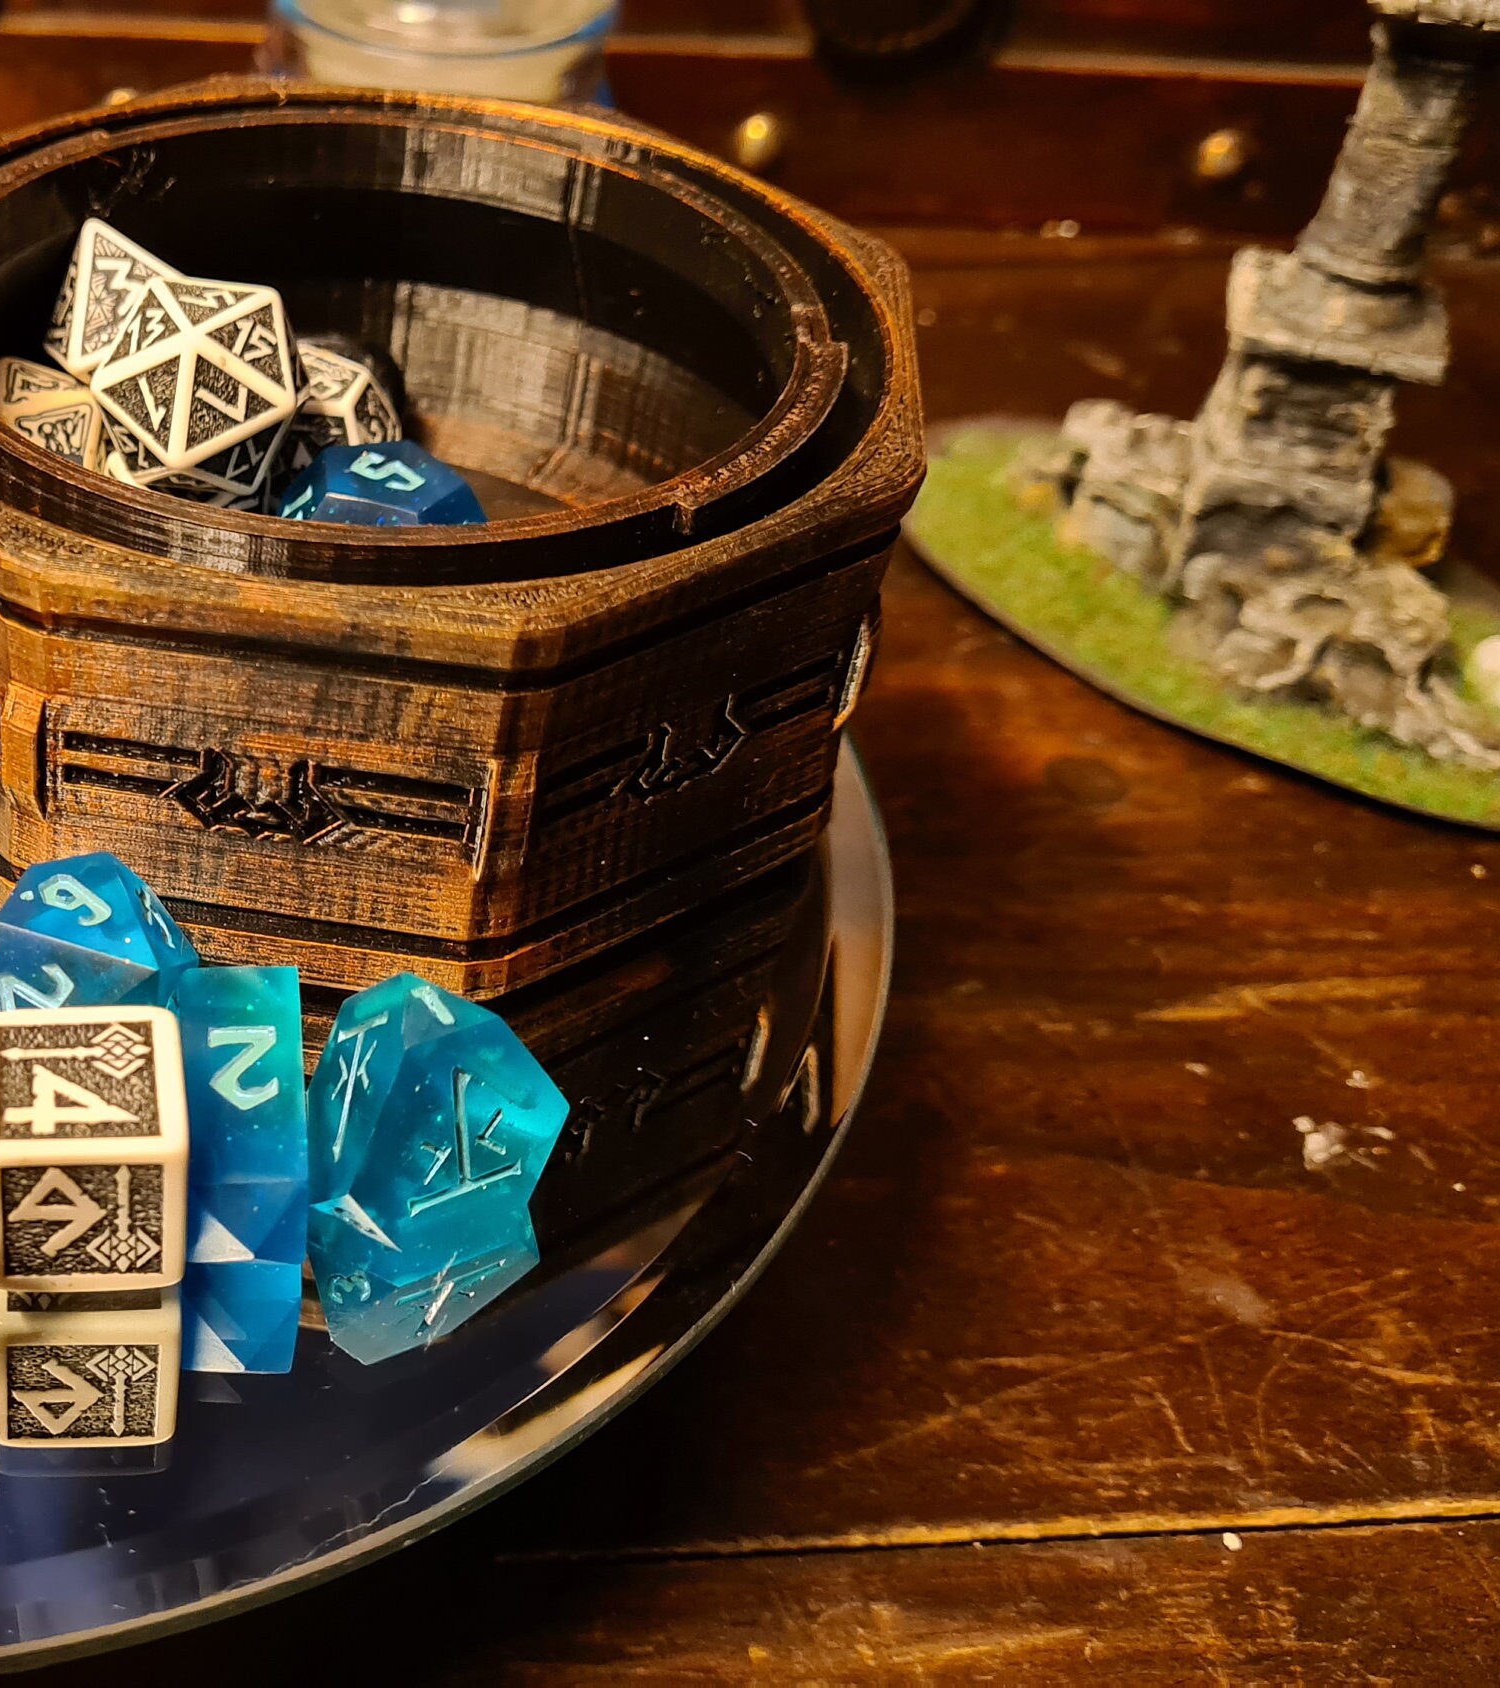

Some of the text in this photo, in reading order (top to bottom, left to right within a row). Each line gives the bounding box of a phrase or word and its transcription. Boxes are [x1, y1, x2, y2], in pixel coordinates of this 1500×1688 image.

[230, 319, 277, 361] 15
[4, 1066, 139, 1133] 4
[208, 1026, 278, 1110] 2
